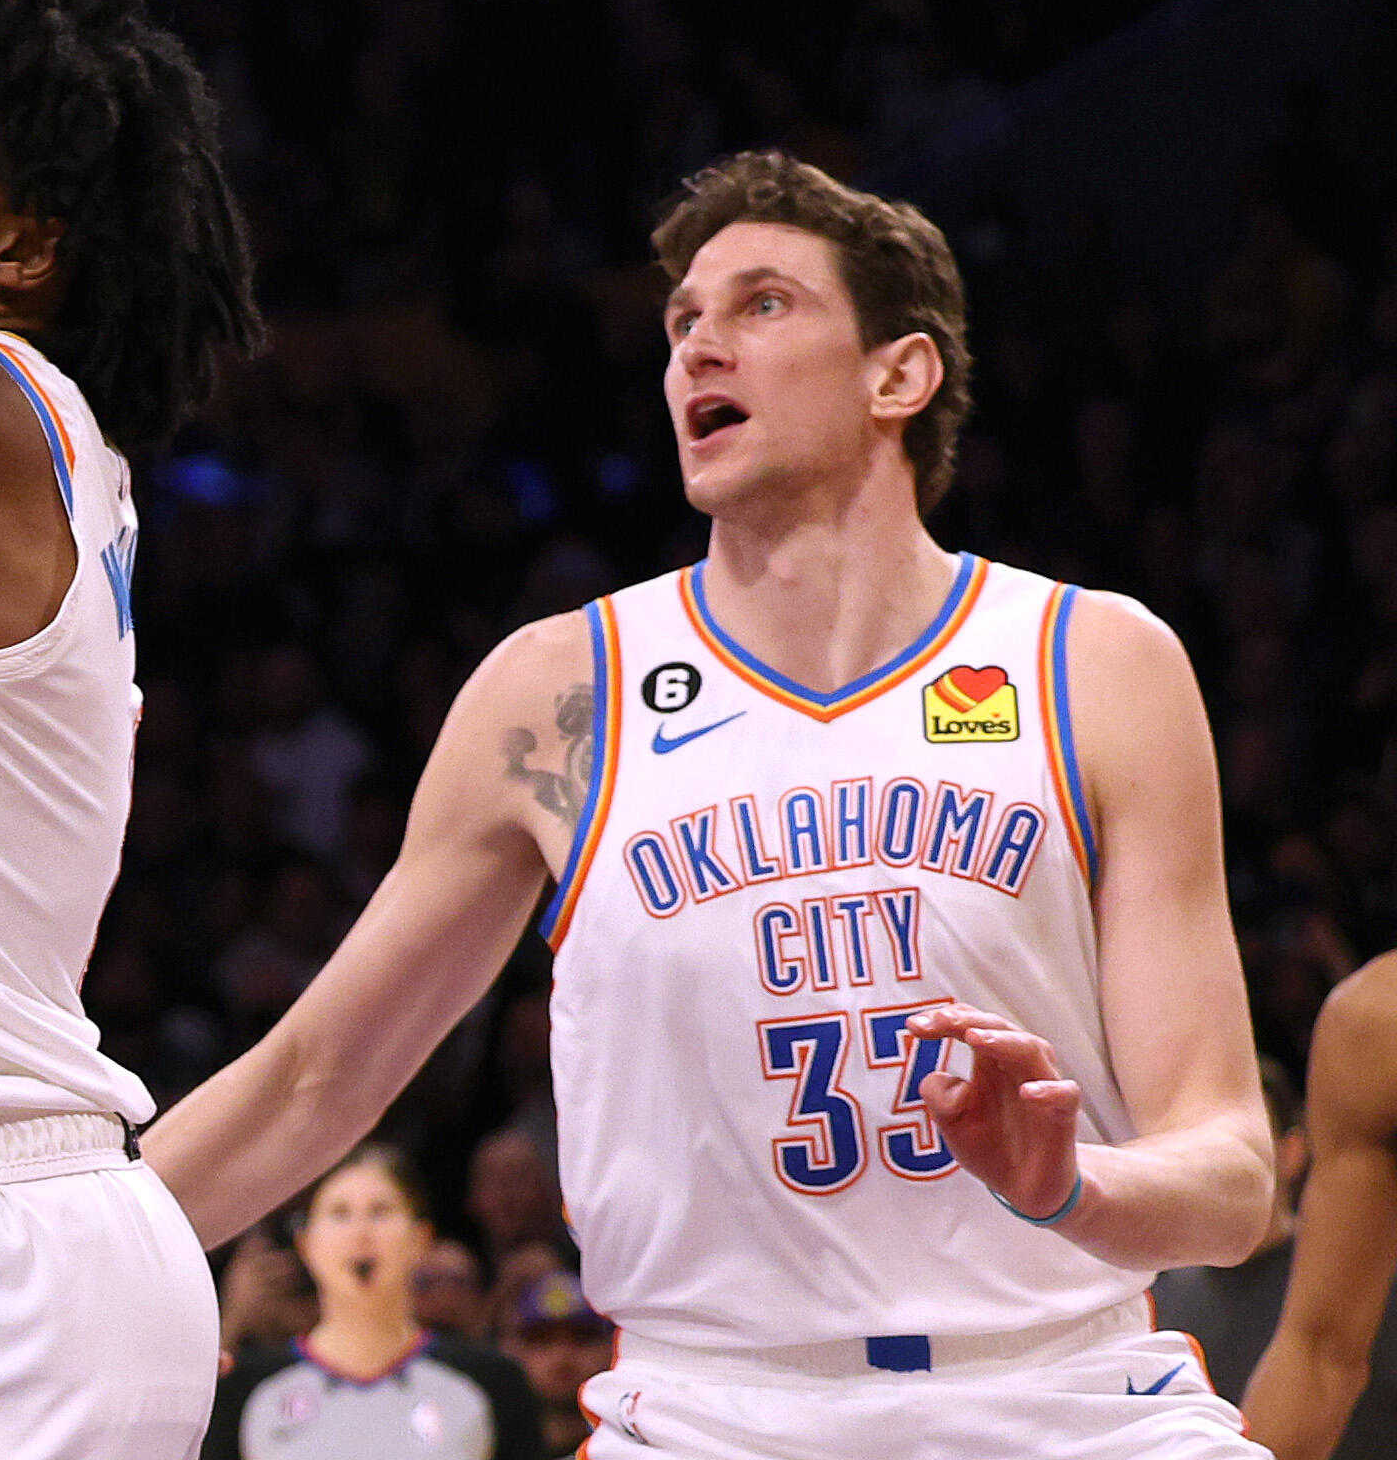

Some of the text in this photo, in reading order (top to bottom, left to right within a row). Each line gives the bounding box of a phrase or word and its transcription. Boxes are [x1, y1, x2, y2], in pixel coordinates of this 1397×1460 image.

[653, 667, 690, 708] 6
[623, 775, 1047, 919] OKLAHOMA
[753, 887, 920, 996] CITY
[755, 996, 961, 1198] 33
